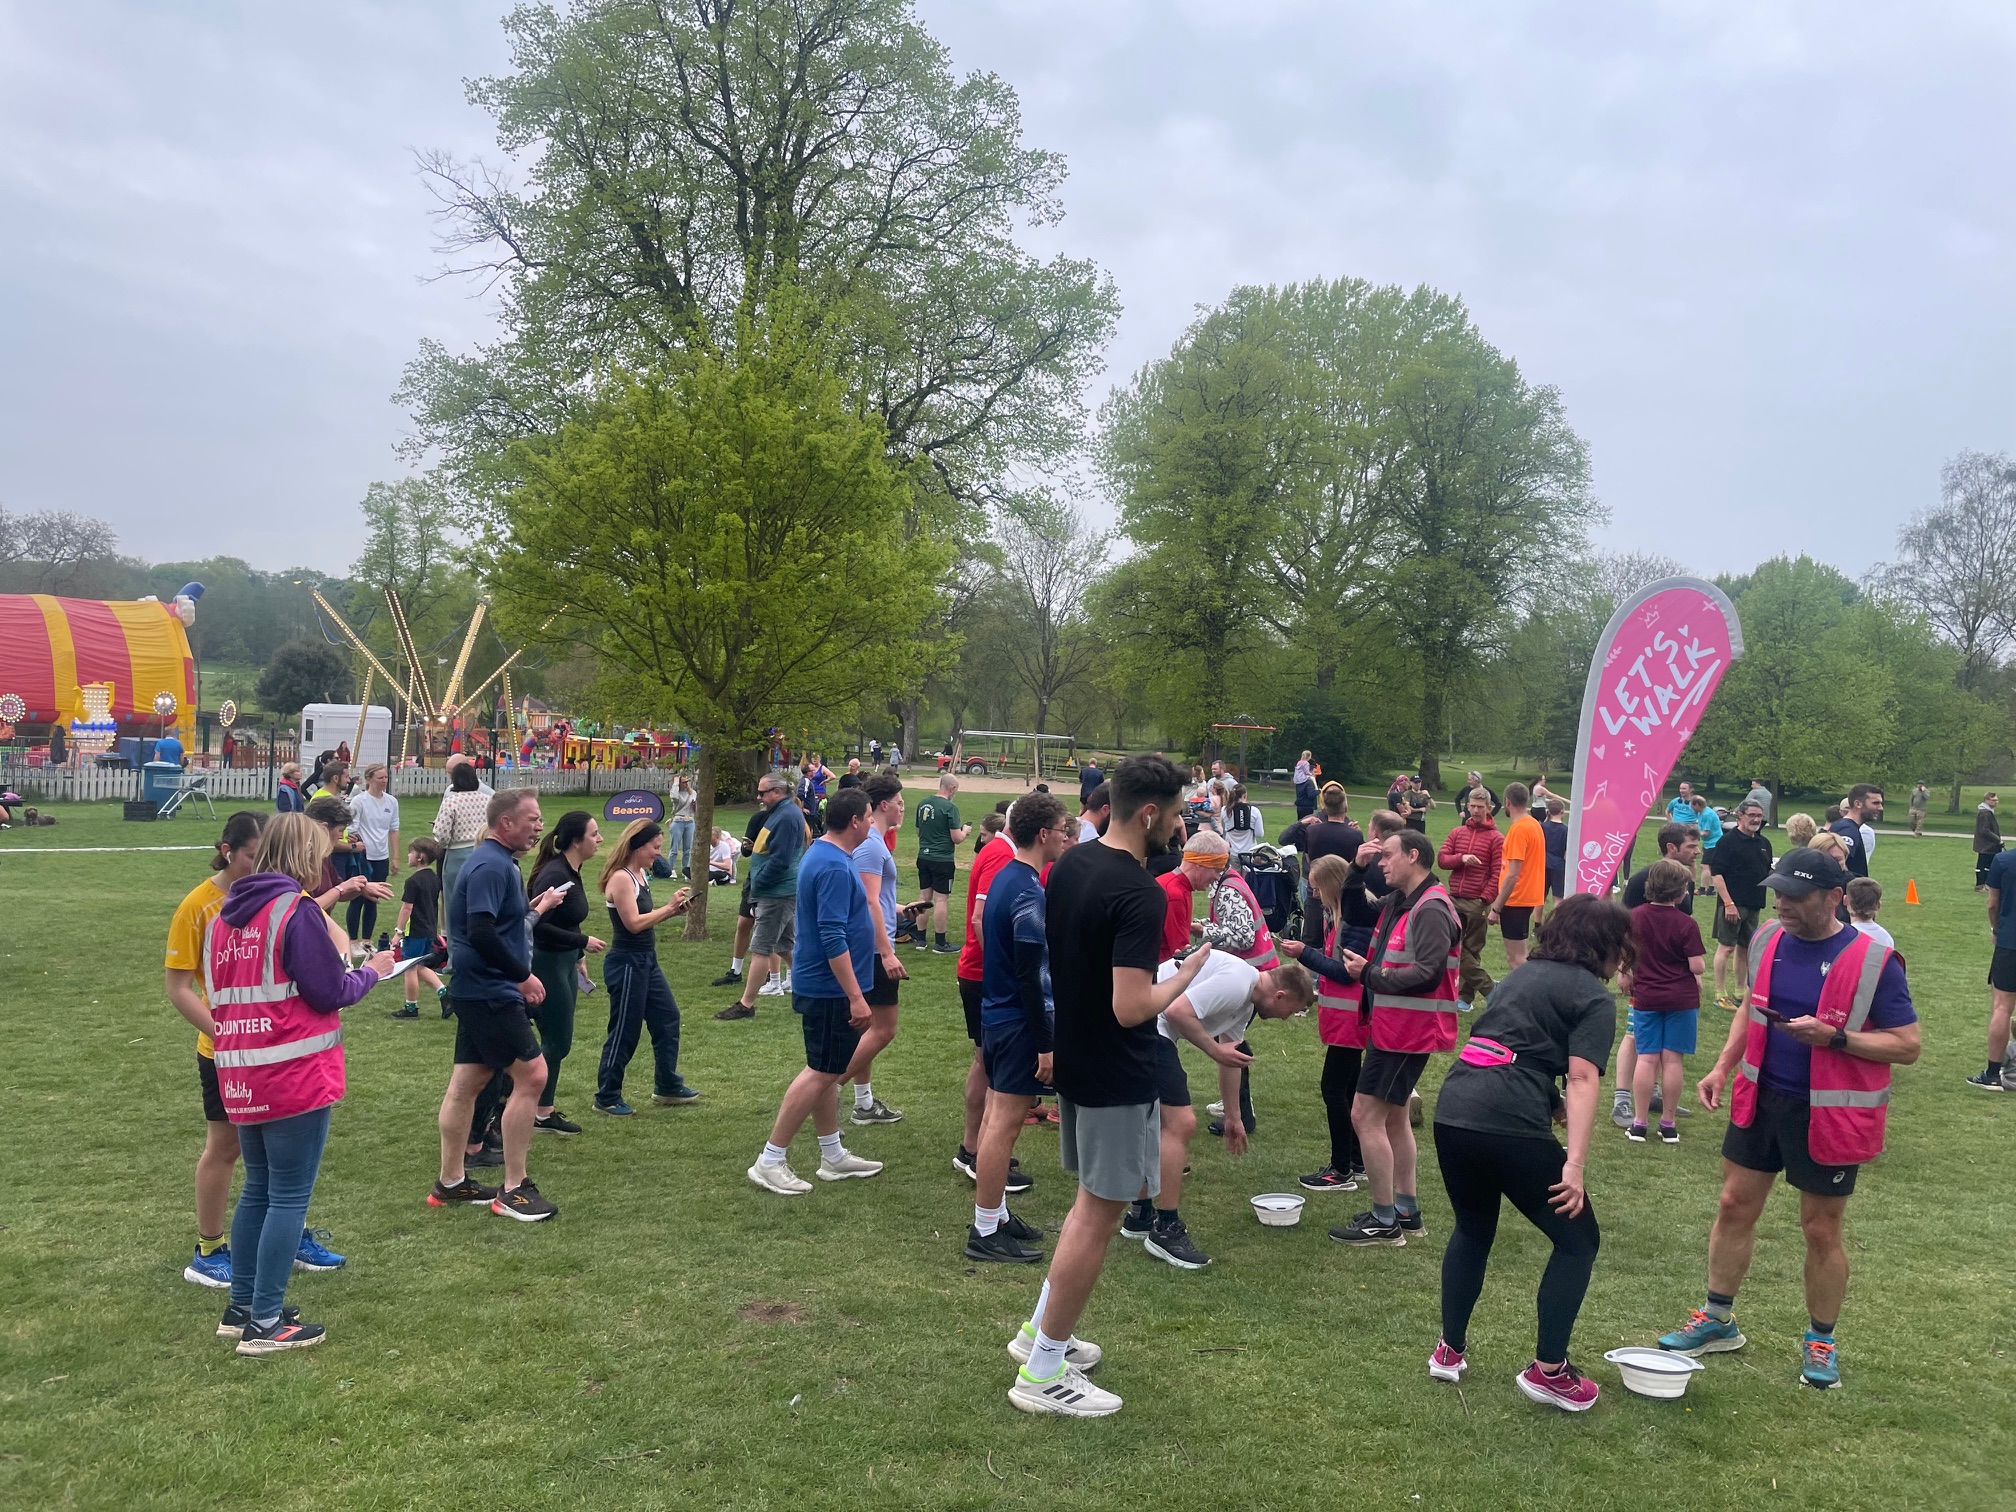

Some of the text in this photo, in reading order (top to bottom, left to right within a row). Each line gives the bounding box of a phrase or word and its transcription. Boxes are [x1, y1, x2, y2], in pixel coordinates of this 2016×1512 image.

[1599, 630, 1679, 736] LET'S
[1629, 637, 1716, 736] WALK
[612, 806, 653, 815] Beacon
[1579, 830, 1630, 896] arkwalk
[1793, 870, 1813, 880] 2XU
[216, 928, 259, 970] parkun
[214, 1017, 273, 1036] OLUNTEER
[224, 1077, 252, 1105] Vitality
